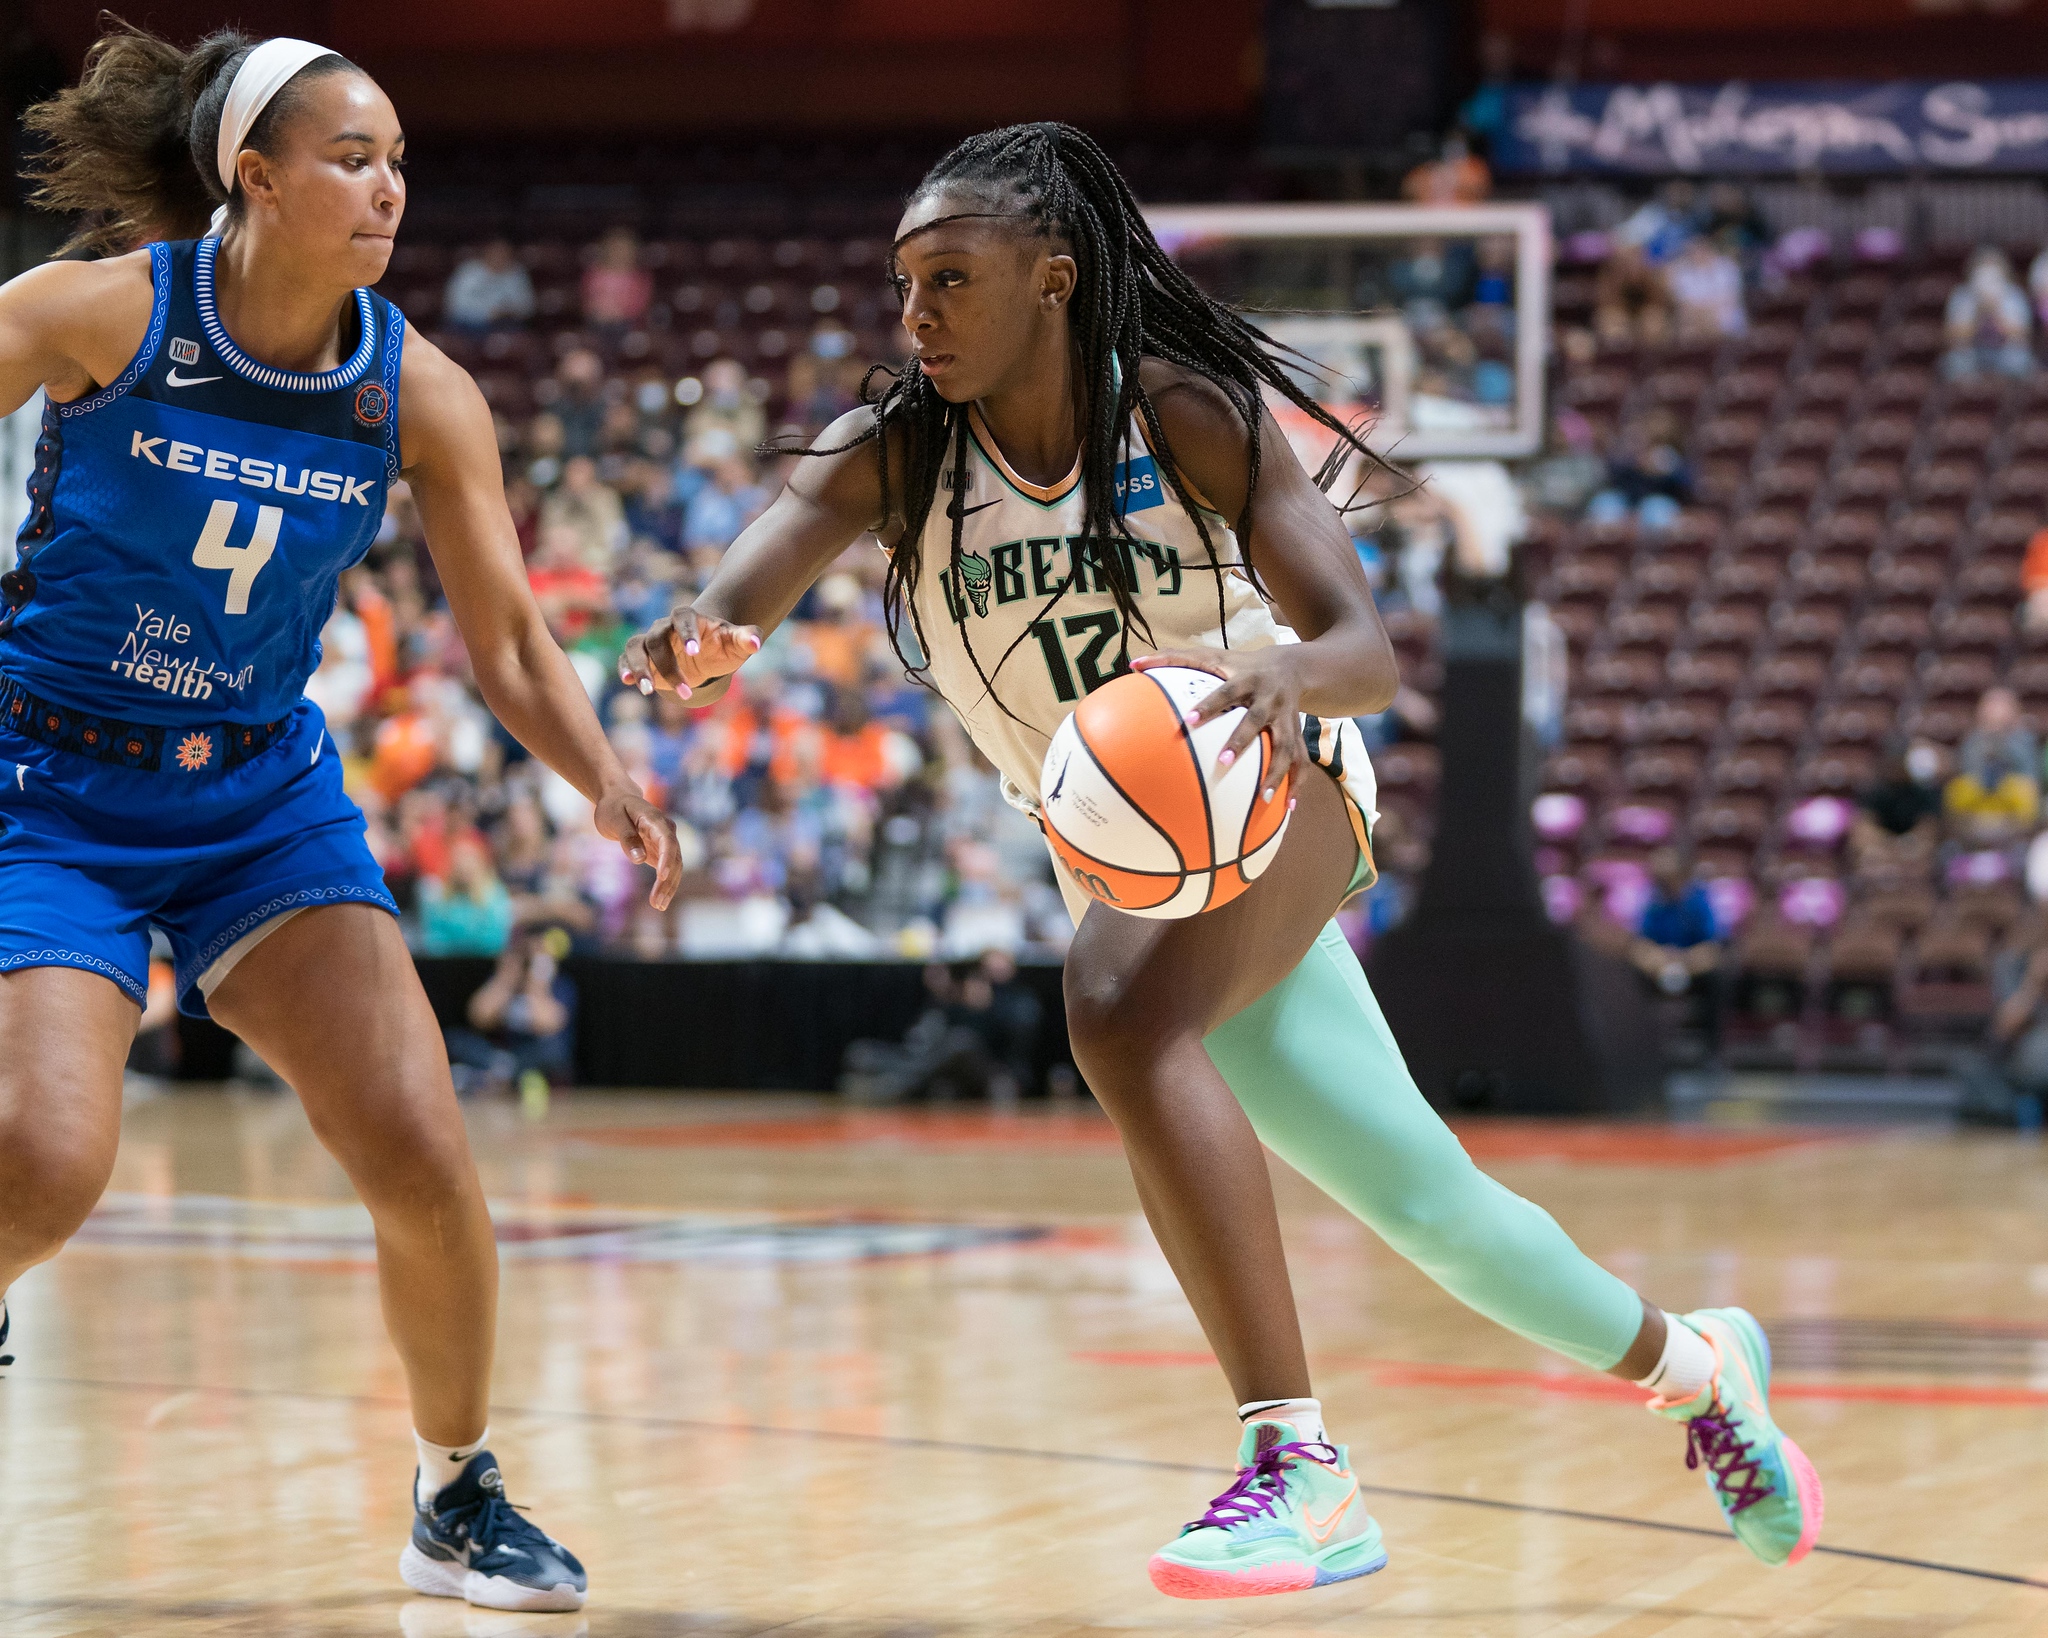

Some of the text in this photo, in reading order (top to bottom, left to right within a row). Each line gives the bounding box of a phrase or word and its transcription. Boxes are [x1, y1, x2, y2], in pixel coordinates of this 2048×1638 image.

[130, 430, 376, 506] KEESUSK
[1115, 473, 1155, 498] HSS
[192, 499, 284, 614] 4
[135, 602, 192, 645] Yale
[1027, 608, 1134, 703] 12
